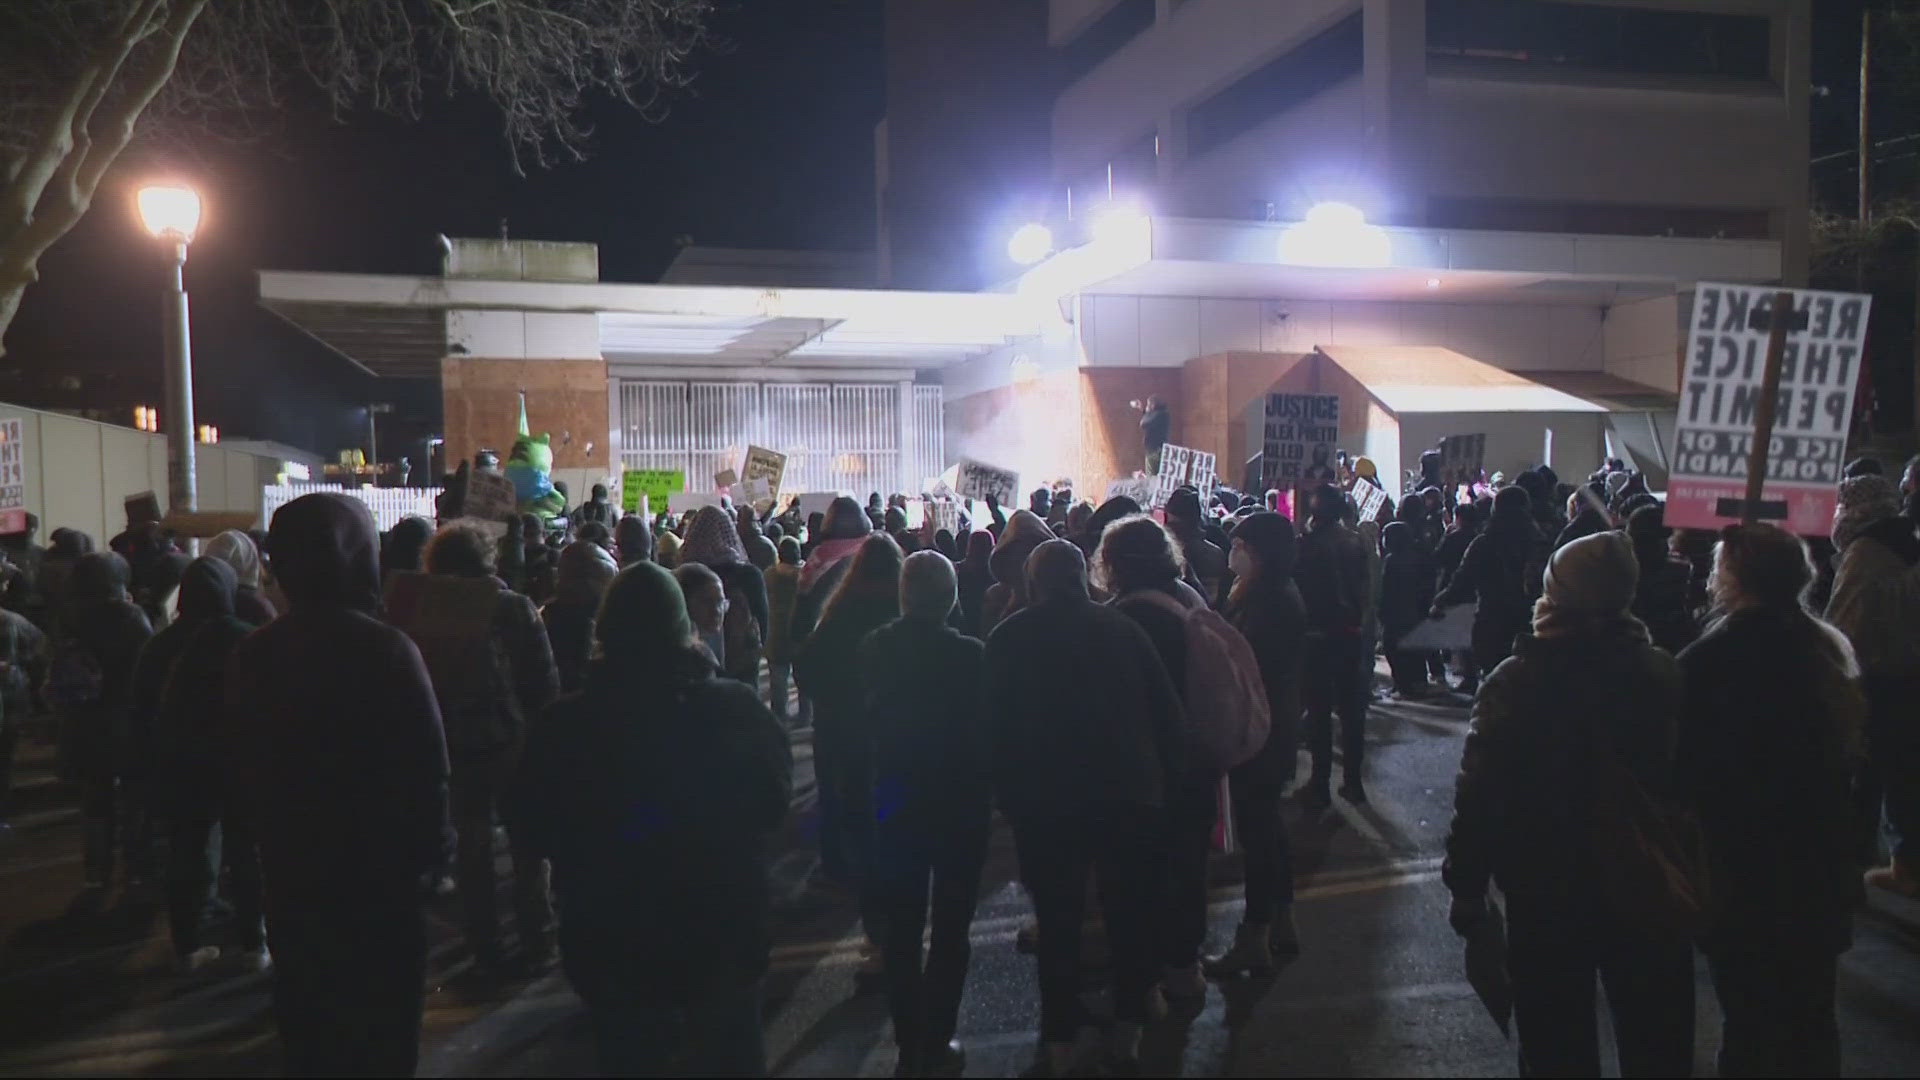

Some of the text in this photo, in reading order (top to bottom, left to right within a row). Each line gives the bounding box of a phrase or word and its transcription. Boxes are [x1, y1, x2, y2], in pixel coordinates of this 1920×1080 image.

[1265, 393, 1339, 420] JUSTICE
[1264, 424, 1294, 441] ALEX
[1263, 442, 1304, 460] KILLED
[1281, 461, 1301, 478] ICE
